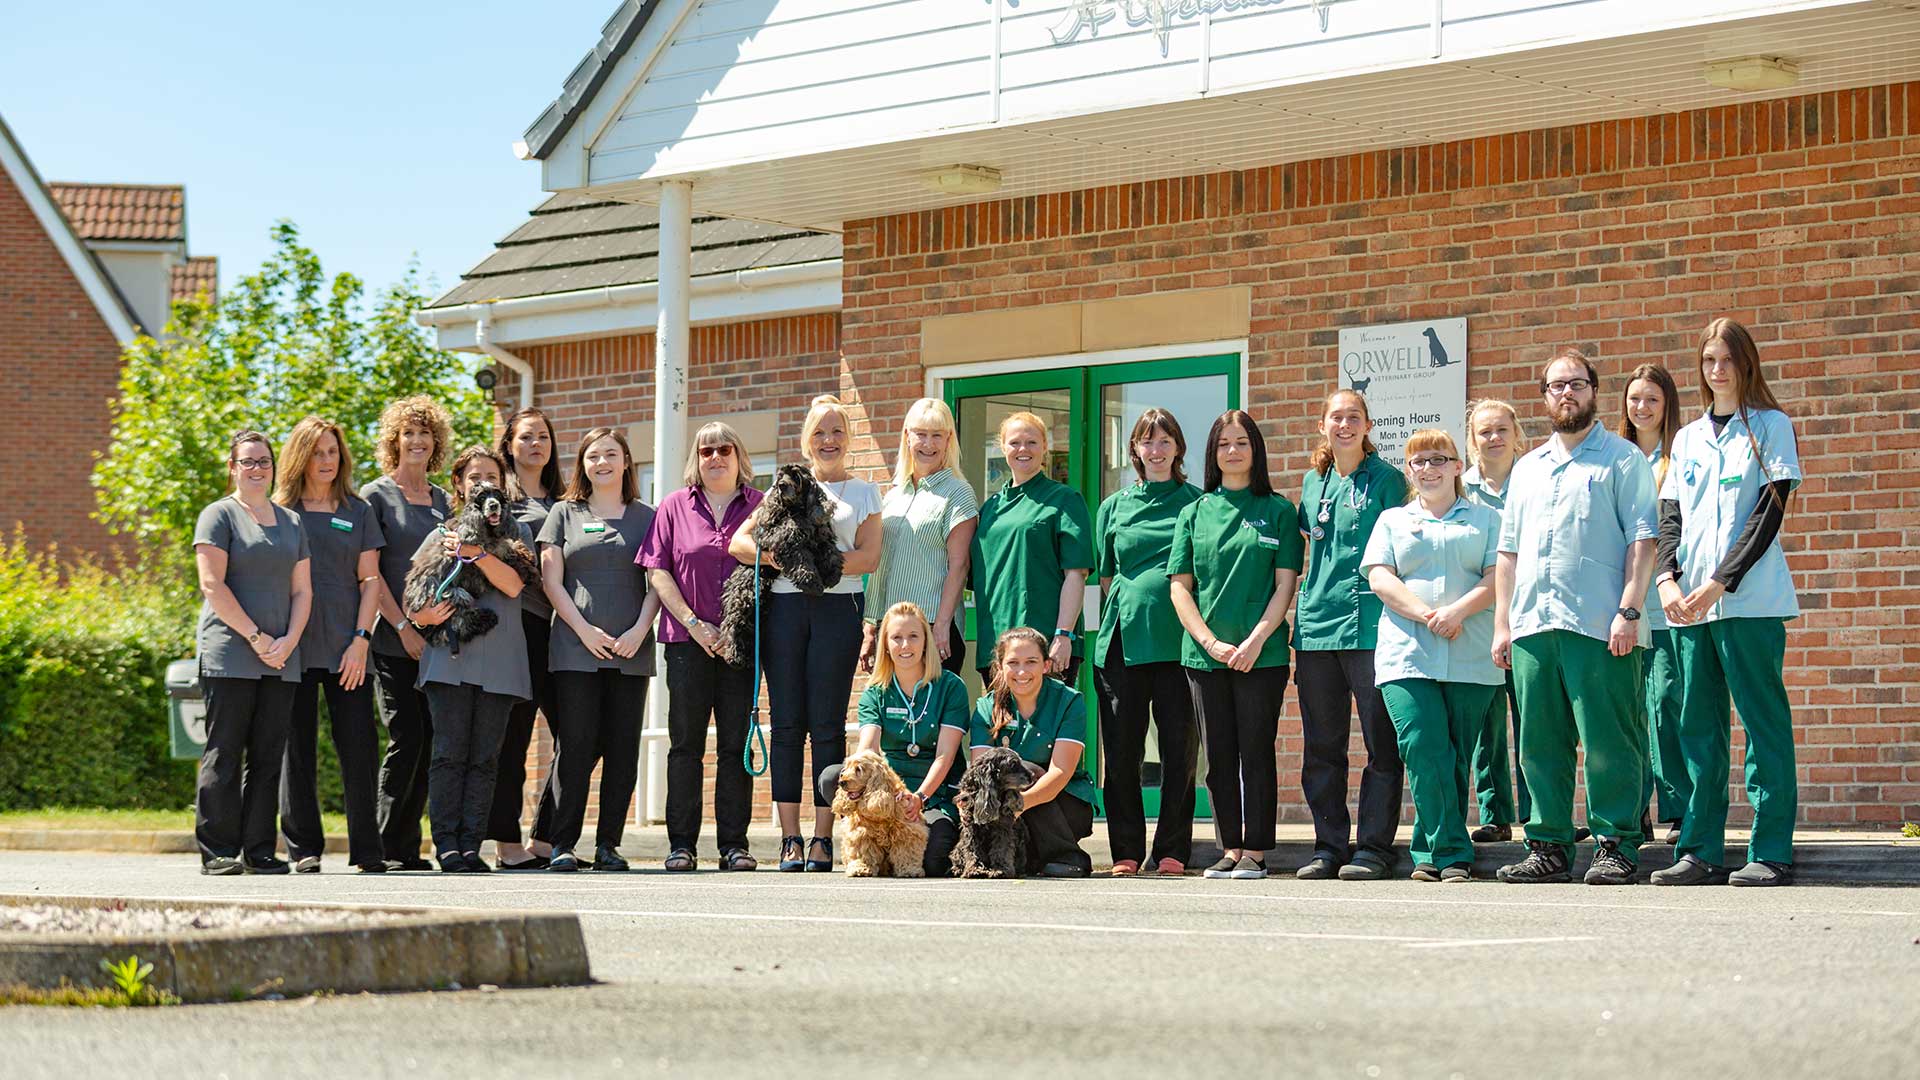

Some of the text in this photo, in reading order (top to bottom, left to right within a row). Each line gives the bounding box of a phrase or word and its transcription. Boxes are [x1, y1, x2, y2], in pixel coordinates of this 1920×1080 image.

[1343, 347, 1426, 375] ORWELL
[1374, 371, 1436, 382] VETERINARY GROUP
[1372, 412, 1441, 427] pening Hours
[1380, 431, 1397, 440] Mon
[1400, 430, 1409, 439] to
